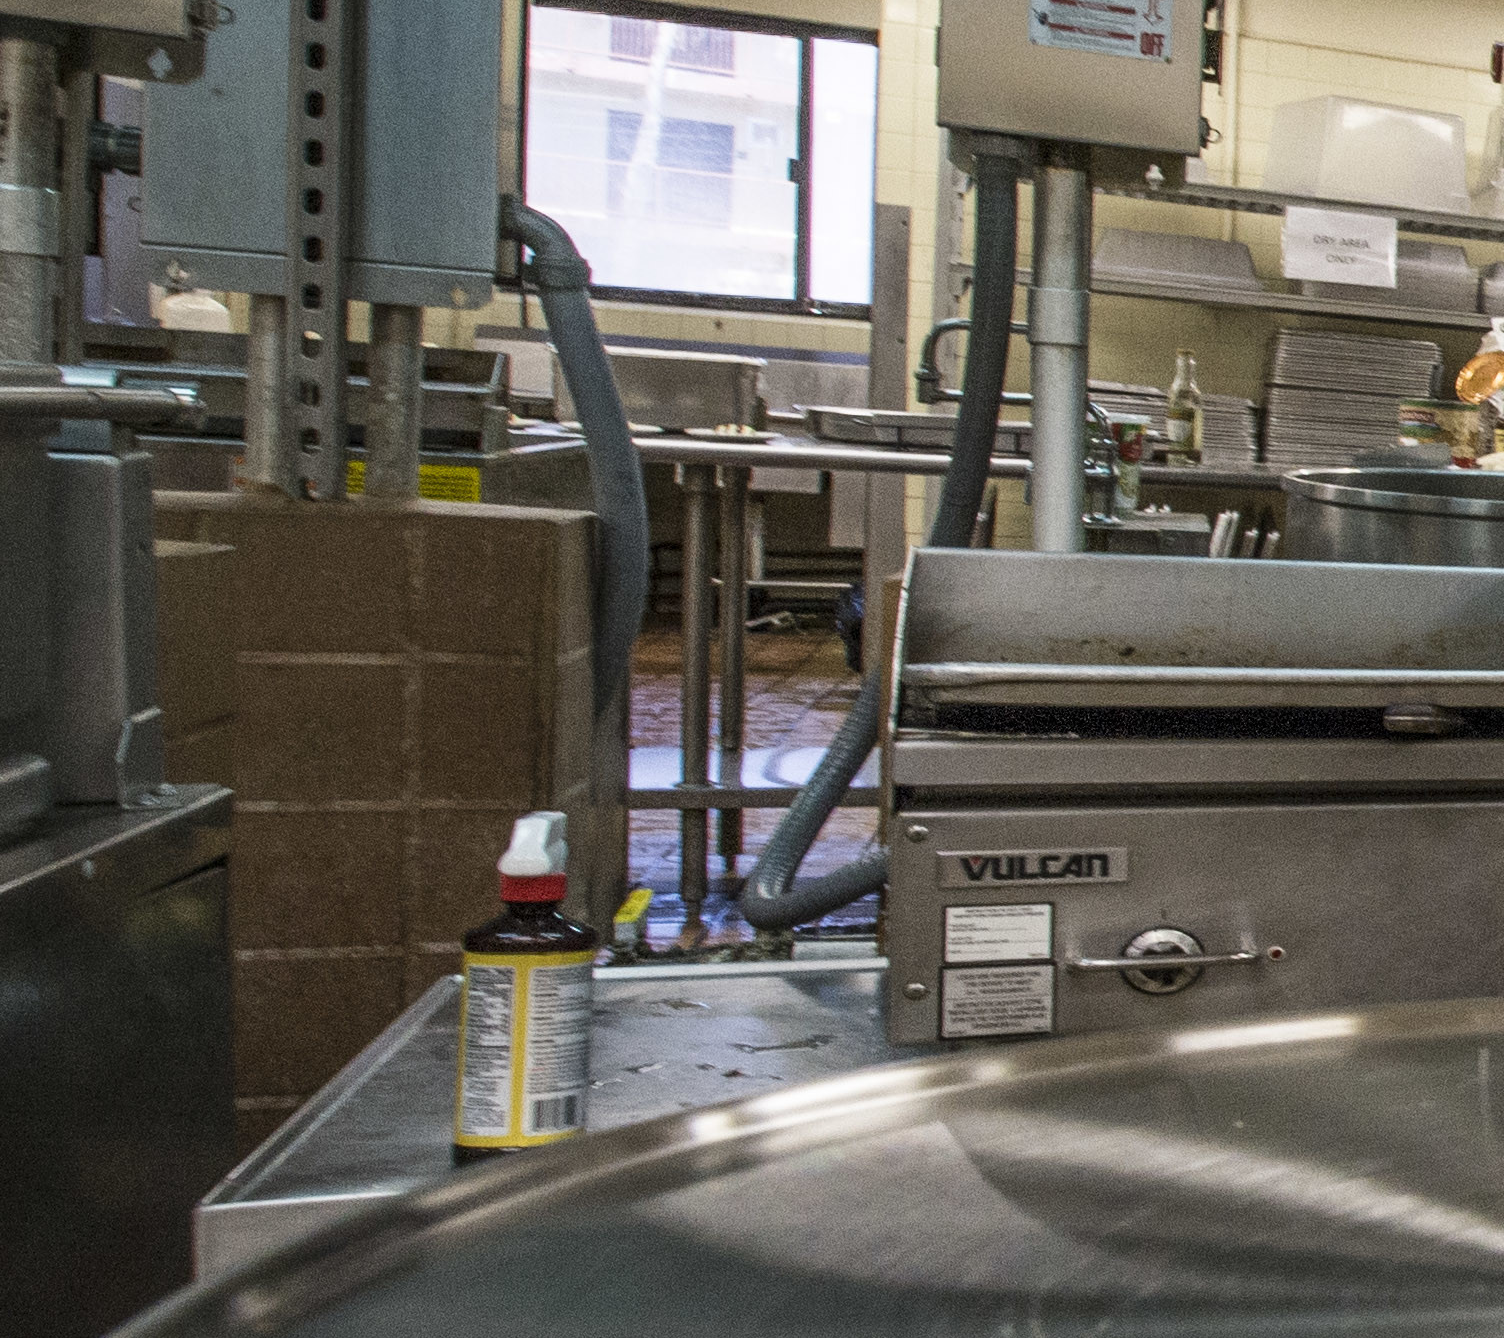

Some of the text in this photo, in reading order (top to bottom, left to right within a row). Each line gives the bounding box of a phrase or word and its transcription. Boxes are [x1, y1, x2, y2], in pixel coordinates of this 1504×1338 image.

[1140, 31, 1165, 57] OFF
[1312, 234, 1370, 249] DRY AREA
[1325, 253, 1358, 264] ONLY
[960, 853, 1109, 881] VULCAN
